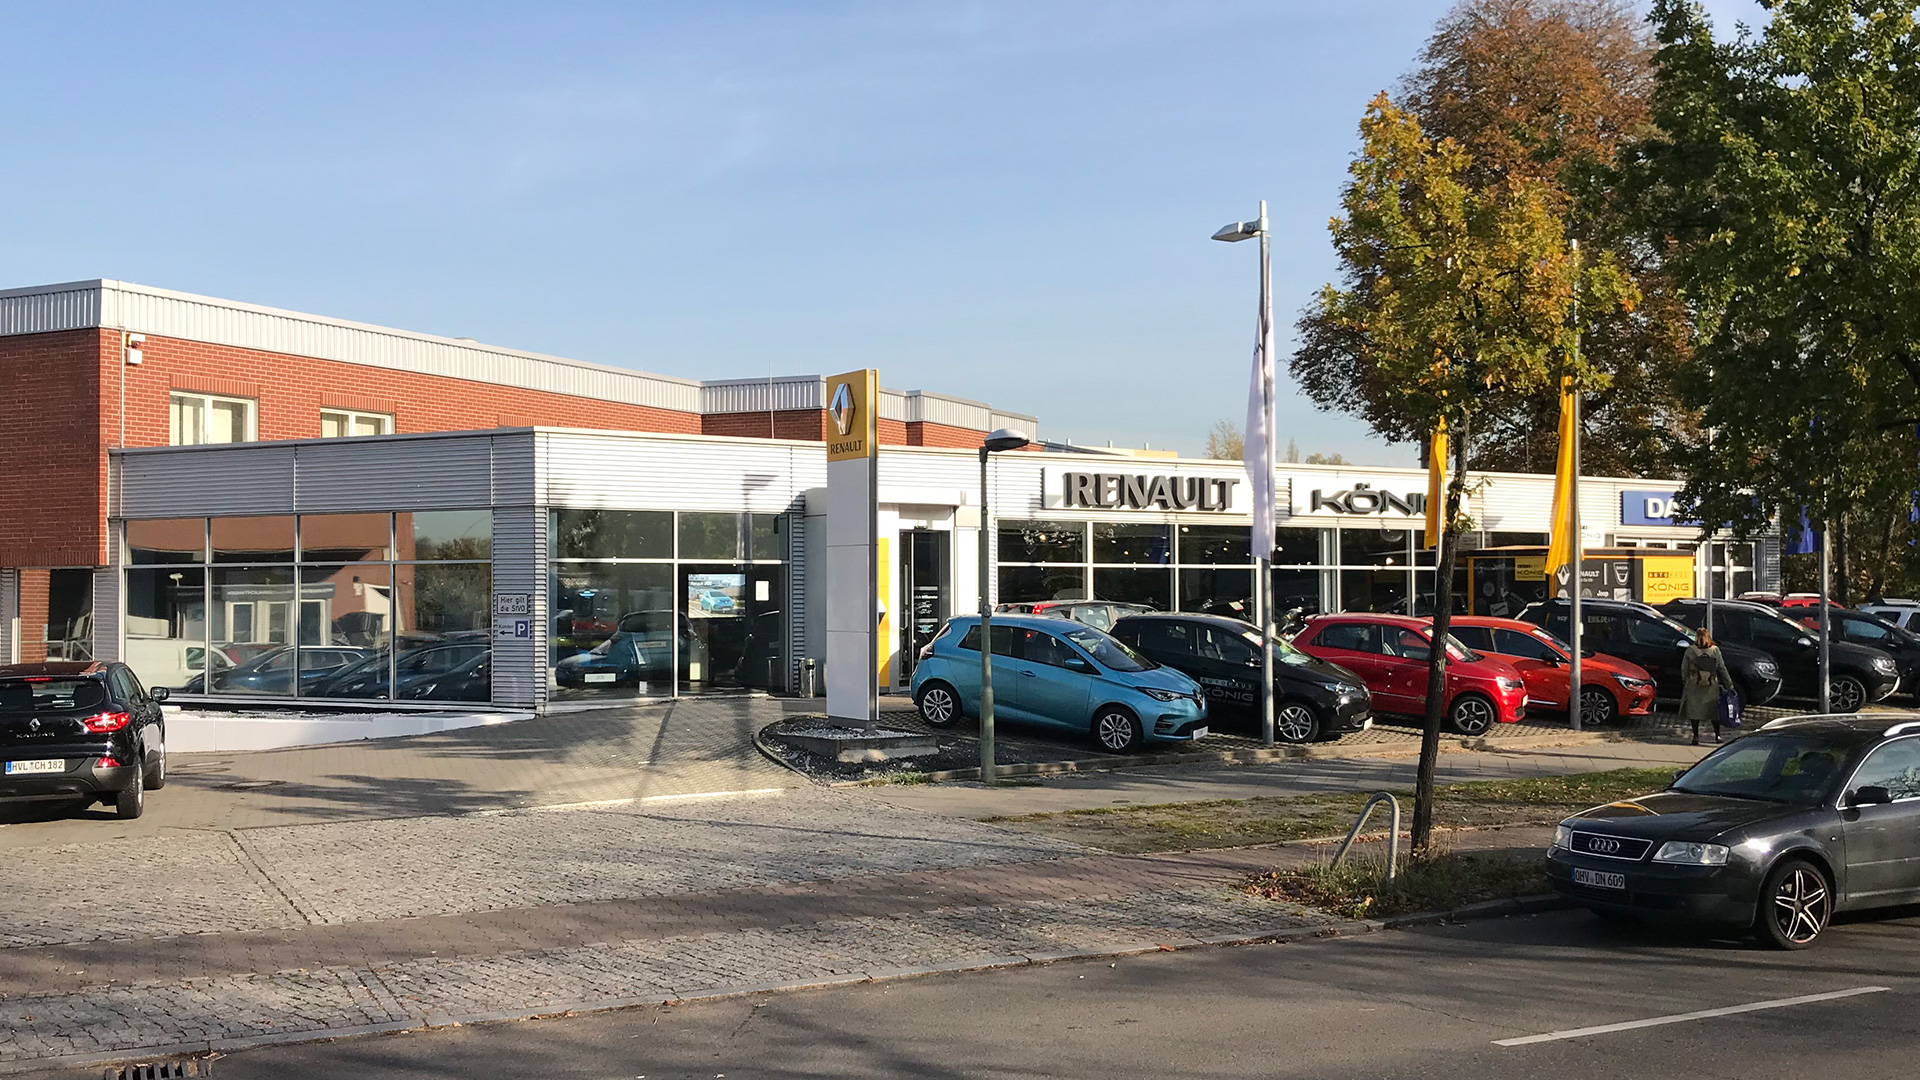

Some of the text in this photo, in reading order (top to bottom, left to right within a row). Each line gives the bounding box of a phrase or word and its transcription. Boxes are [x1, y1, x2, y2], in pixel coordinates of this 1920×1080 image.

[830, 440, 863, 455] RENAULT
[1062, 472, 1240, 512] RENAULT
[1310, 482, 1428, 517] KÖNI
[1647, 580, 1689, 591] KÖNIG
[517, 623, 526, 636] P
[12, 760, 63, 771] HVL CH 182
[1575, 869, 1624, 888] OHV DN 609
